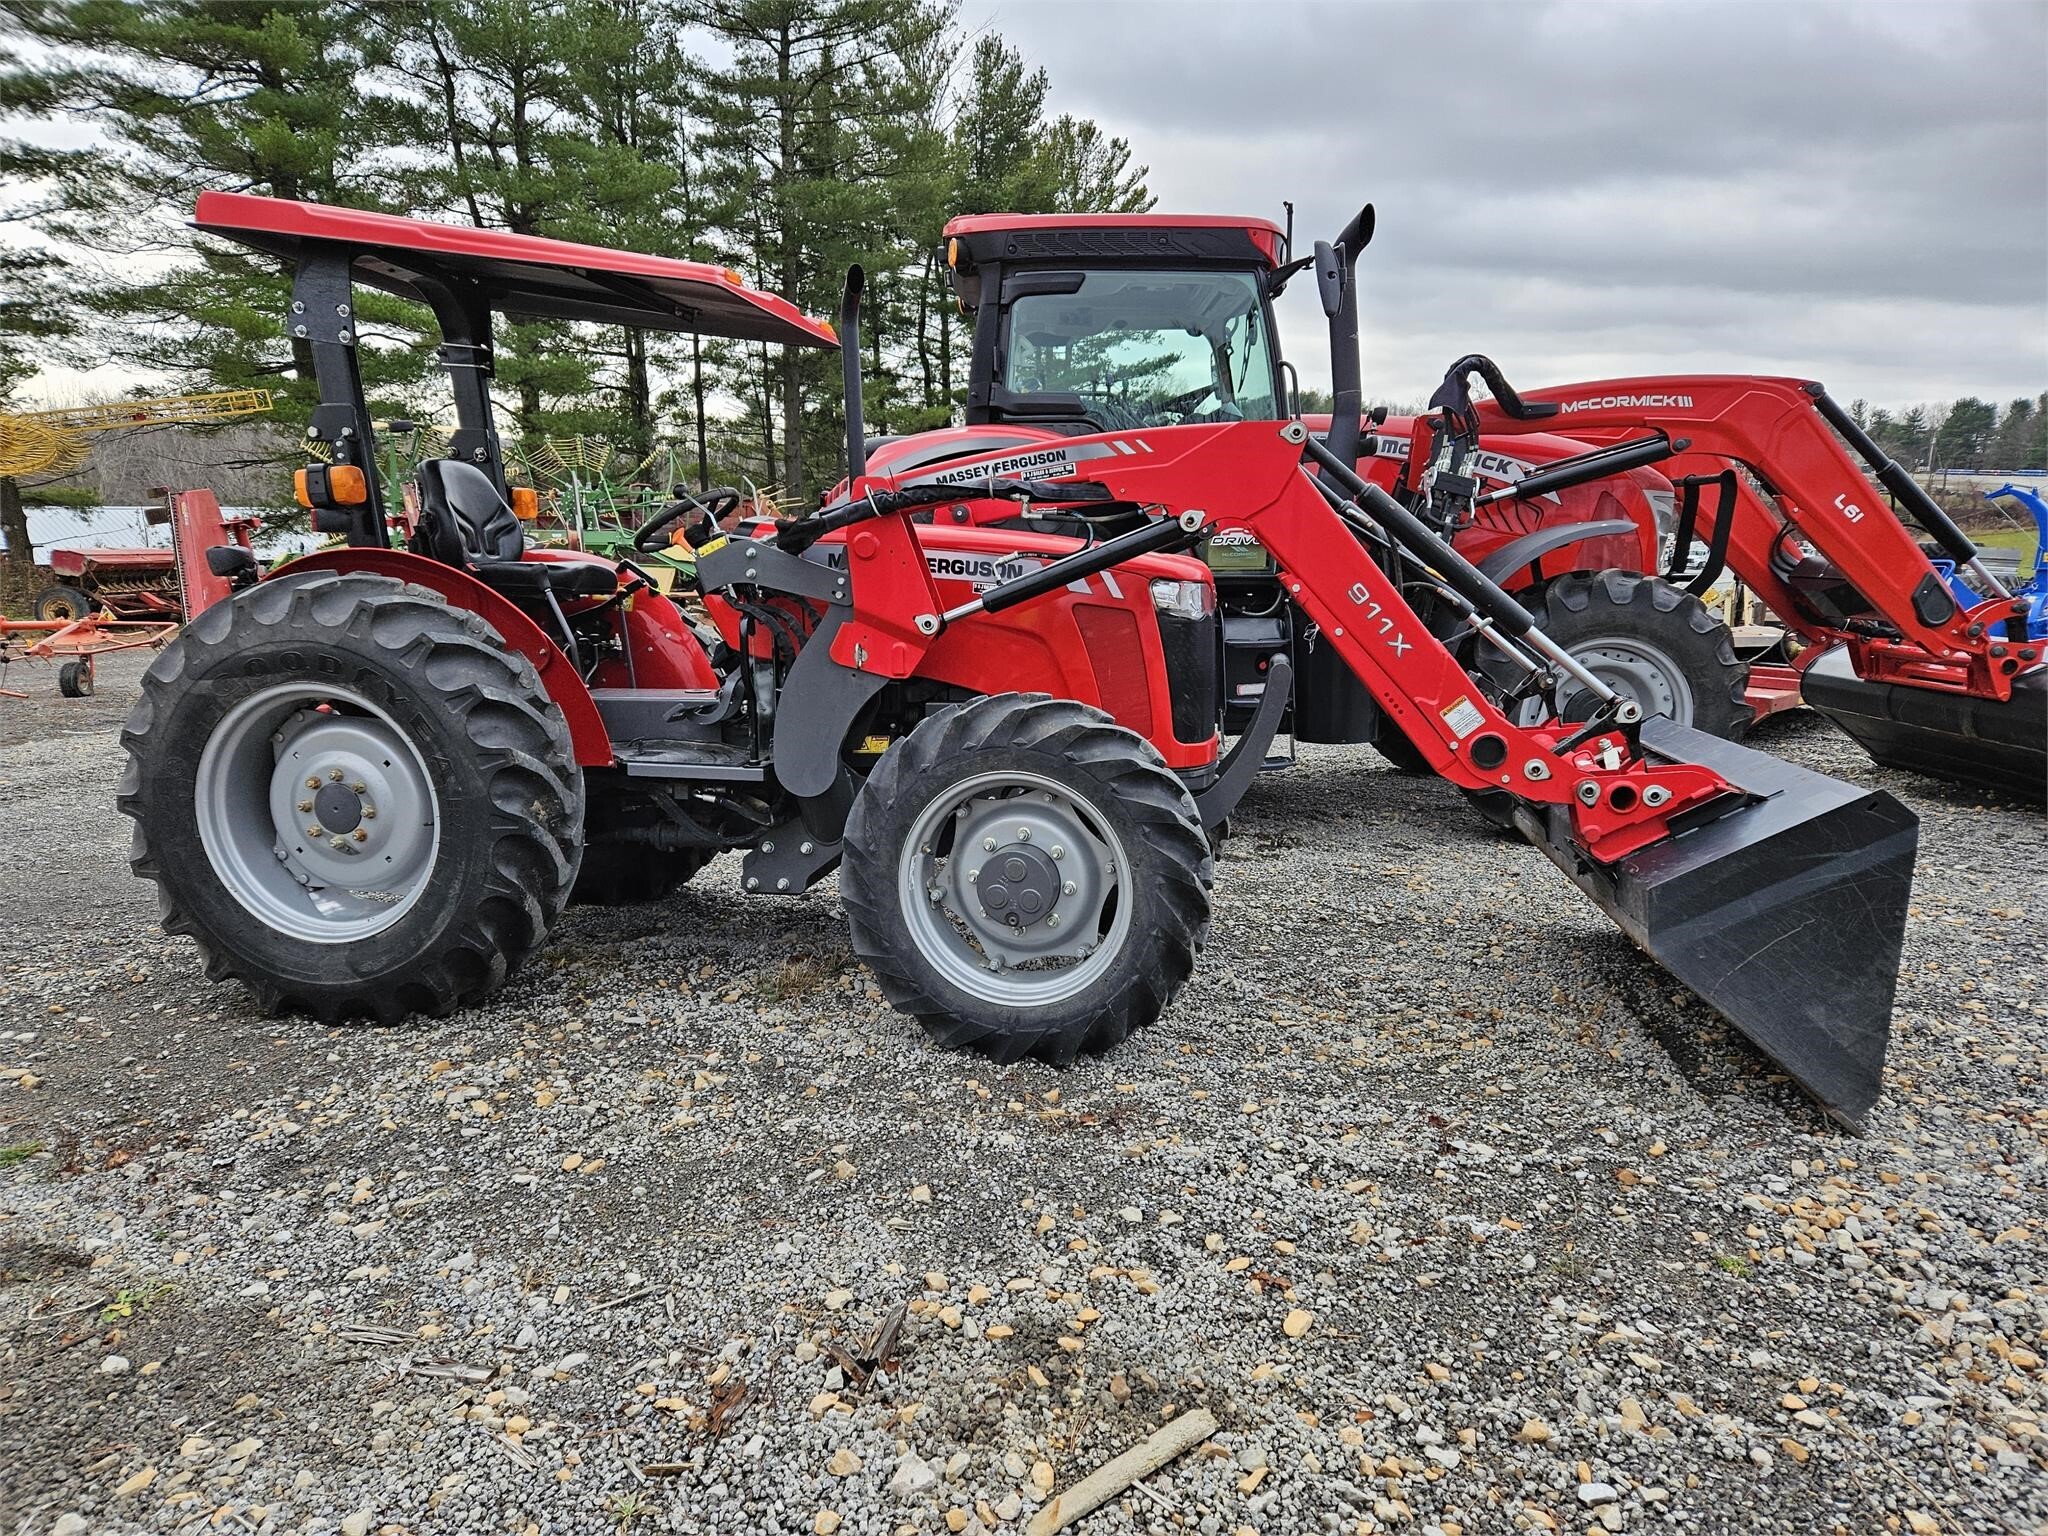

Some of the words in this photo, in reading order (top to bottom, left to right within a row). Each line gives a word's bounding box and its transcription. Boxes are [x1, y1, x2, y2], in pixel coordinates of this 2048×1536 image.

[935, 464, 990, 485] MASSEY
[993, 450, 1067, 473] FERGUSON
[1834, 493, 1865, 523] L61
[927, 557, 1023, 579] ERGUSON
[1347, 582, 1414, 658] 911X
